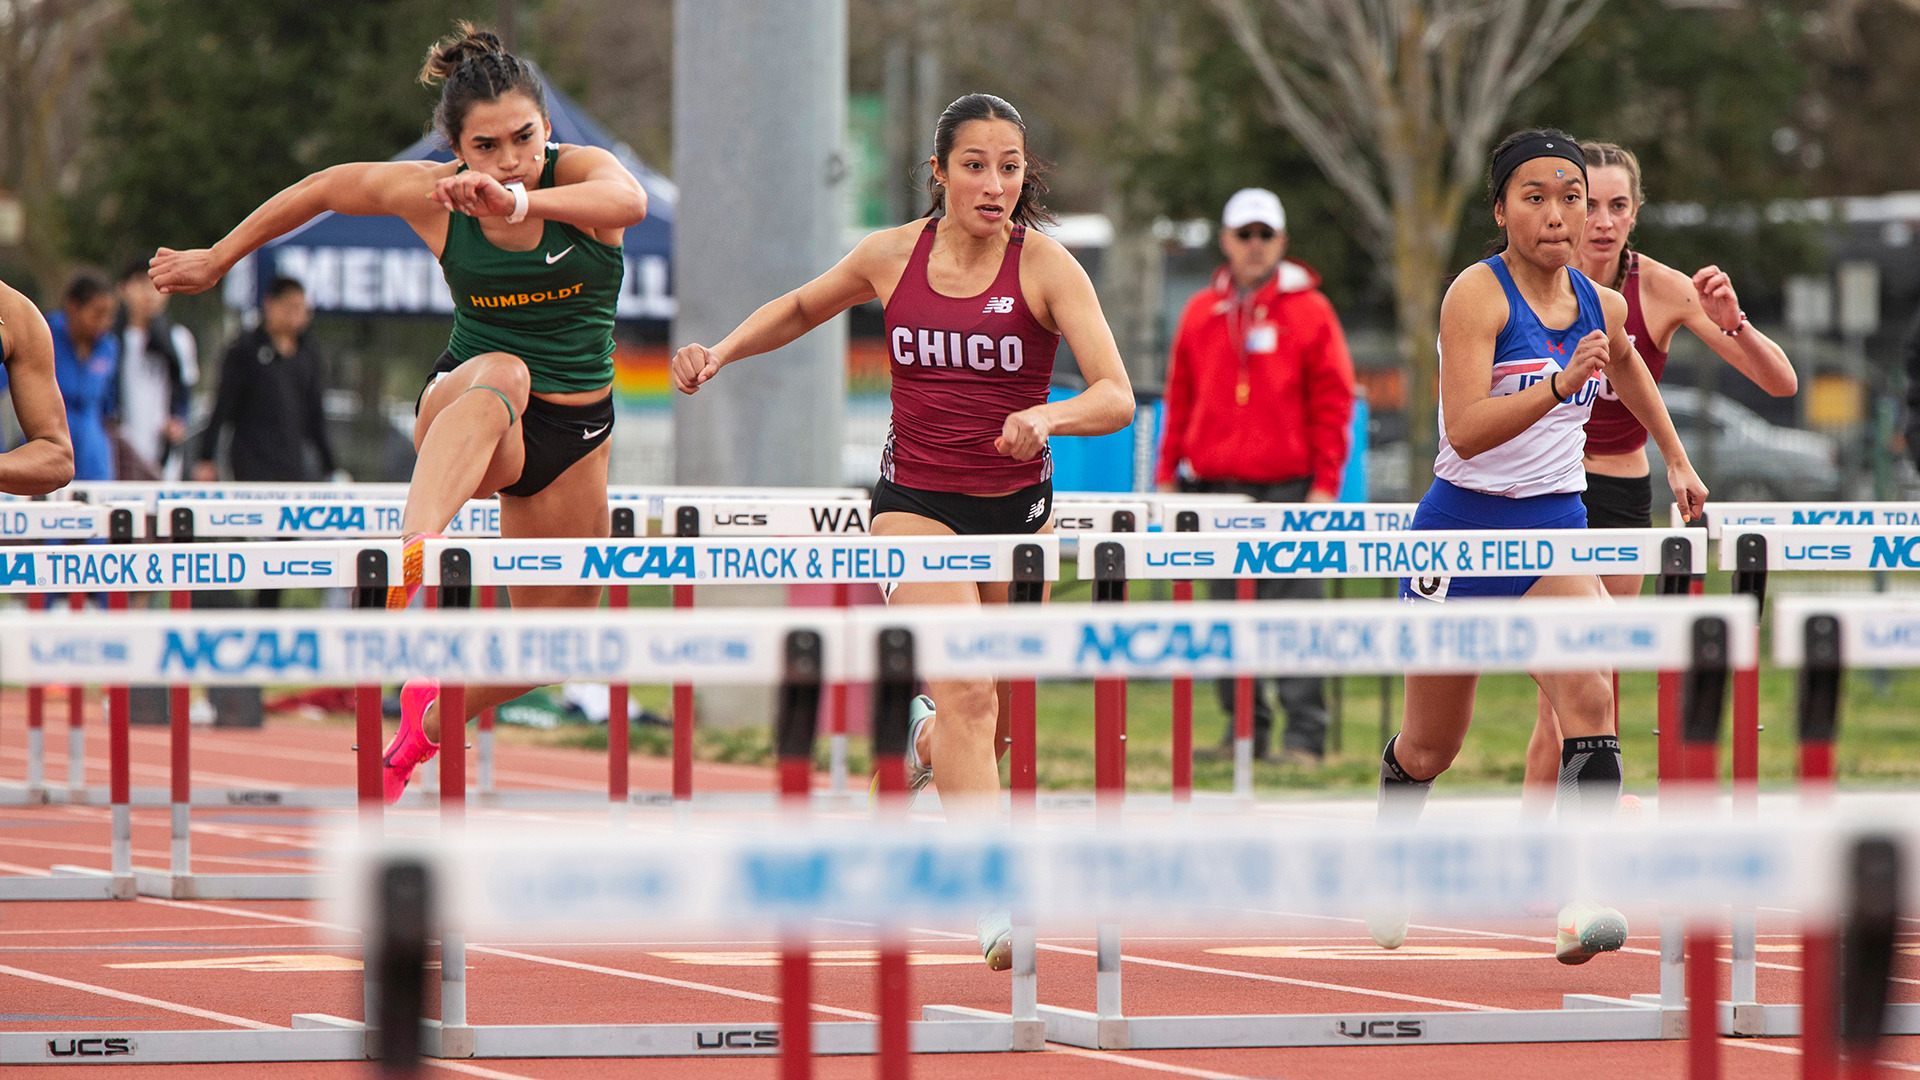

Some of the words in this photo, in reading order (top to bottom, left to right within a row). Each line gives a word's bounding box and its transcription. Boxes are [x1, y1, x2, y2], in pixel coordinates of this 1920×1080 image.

[470, 283, 584, 308] HUMBOLDT
[892, 326, 1024, 372] CHICO
[40, 517, 94, 530] UCS
[210, 513, 264, 526] UCS
[277, 506, 366, 531] NCAA
[373, 507, 404, 531] TR
[715, 513, 768, 526] UCS
[808, 506, 872, 533] WA
[1214, 516, 1266, 529] UCS
[1281, 510, 1366, 532] NCAA
[493, 555, 563, 571] UCS
[580, 545, 697, 580] NCAA
[707, 547, 798, 579] TRACK
[805, 547, 823, 579] &
[831, 547, 905, 579] FIELD
[922, 554, 992, 571] UCS
[1146, 551, 1215, 567] UCS
[1233, 540, 1348, 575] NCAA
[1358, 541, 1449, 573] TRACK
[1456, 540, 1474, 572] &
[1482, 539, 1554, 571] FIELD
[1571, 546, 1639, 562] UCS
[1785, 545, 1851, 561] UCS
[47, 552, 138, 586] TRACK
[146, 551, 164, 585] &
[172, 551, 246, 584] FIELD
[263, 560, 333, 576] UCS
[160, 628, 320, 673] NCAA
[342, 628, 466, 675] TRACK
[517, 627, 629, 674] FIELD
[1075, 622, 1233, 665] NCAA
[697, 1030, 781, 1049] UCS
[1338, 1020, 1423, 1039] UCS
[48, 1037, 130, 1056] UCS
